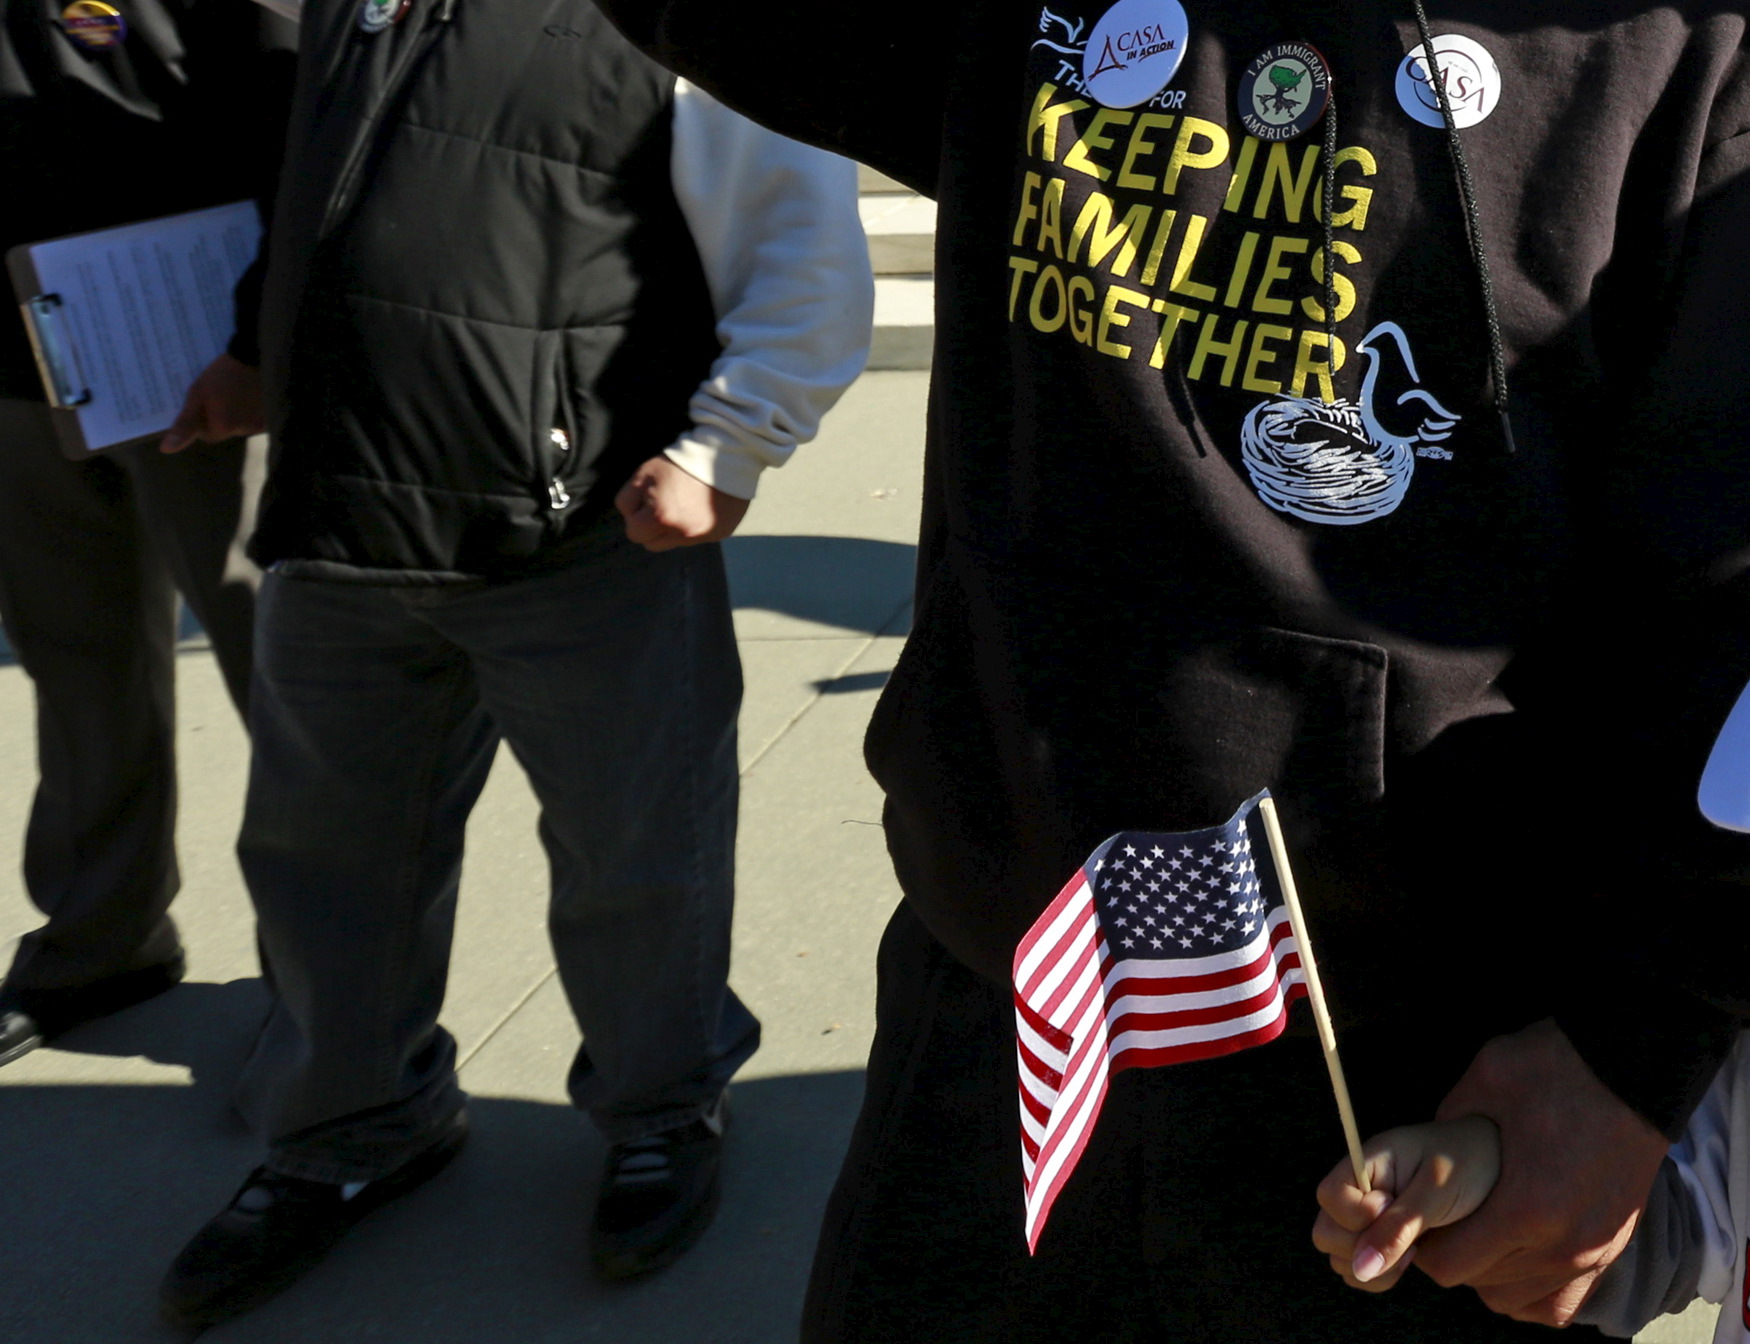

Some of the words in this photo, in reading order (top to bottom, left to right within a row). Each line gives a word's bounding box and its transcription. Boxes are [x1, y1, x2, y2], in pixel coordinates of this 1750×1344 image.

[1117, 24, 1166, 52] CASA
[1126, 50, 1138, 61] IN
[1139, 39, 1175, 58] ACTION
[1255, 50, 1274, 69] AM
[1277, 44, 1327, 91] IMMIGRANT
[1149, 90, 1187, 109] FOR
[1242, 113, 1300, 140] AMERICA
[1026, 81, 1379, 233] KEEPING
[1011, 171, 1364, 325] FAMILIES
[1006, 256, 1347, 405] TOGETHER
